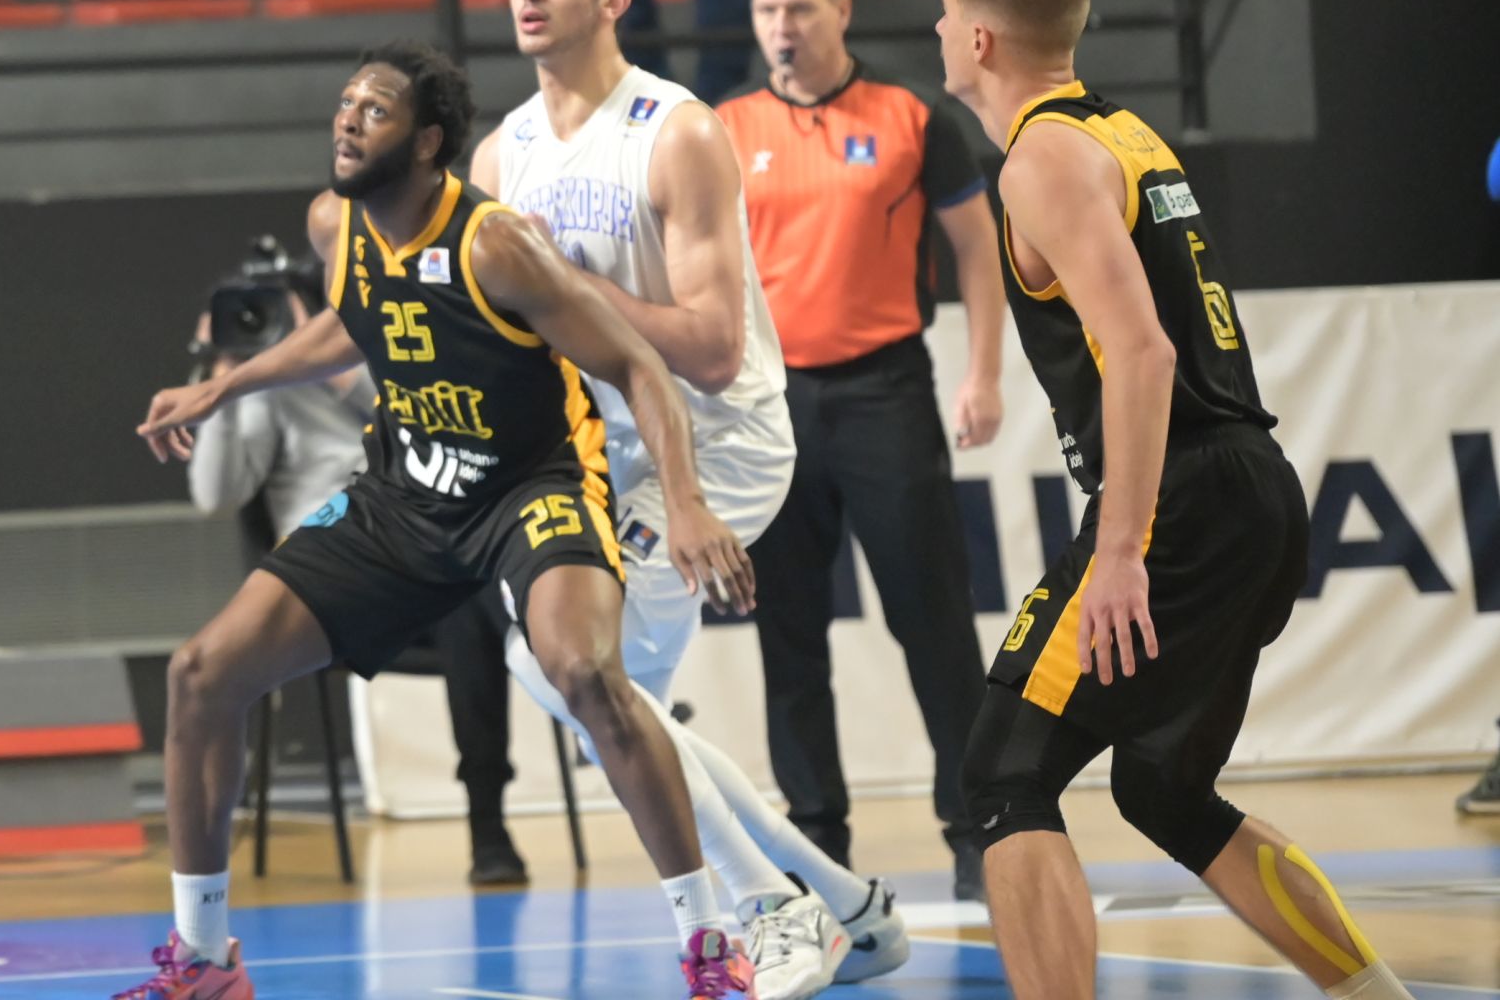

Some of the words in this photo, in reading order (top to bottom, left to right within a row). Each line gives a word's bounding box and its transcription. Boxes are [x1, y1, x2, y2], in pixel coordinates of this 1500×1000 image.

[380, 301, 436, 362] 25
[519, 494, 583, 550] 25
[1003, 587, 1050, 653] 6
